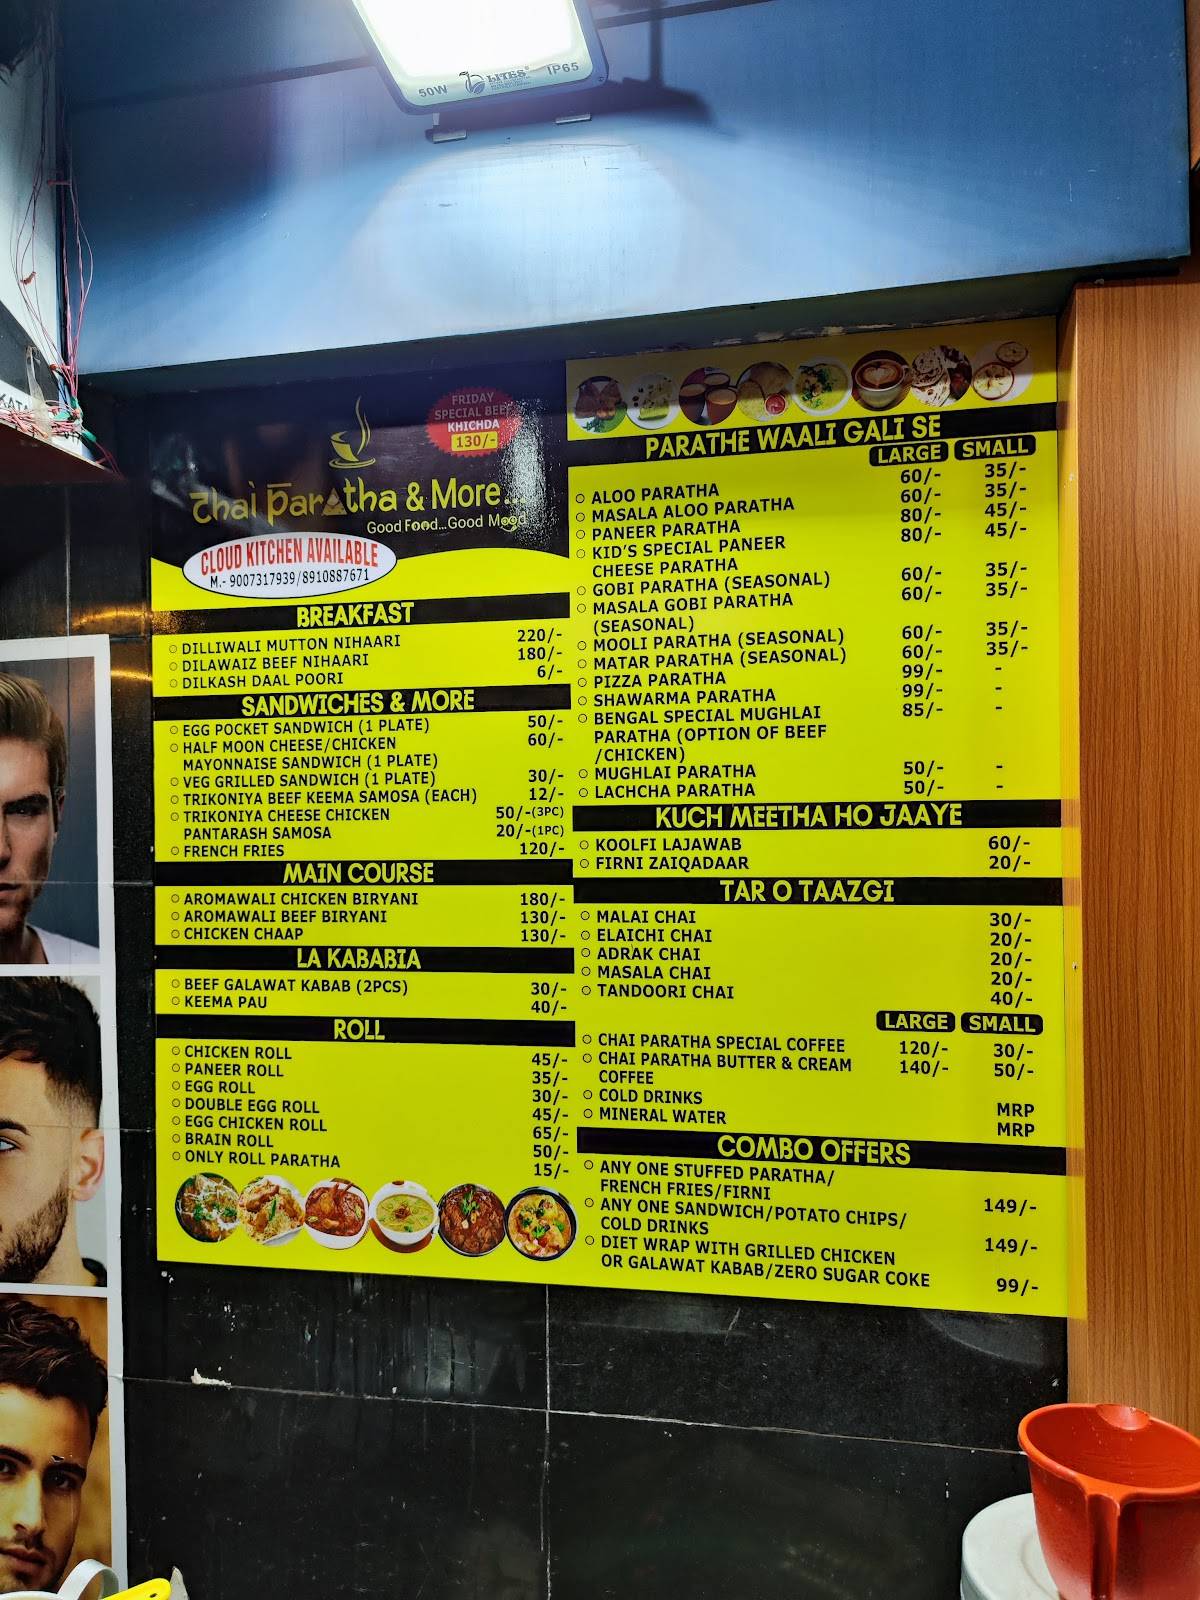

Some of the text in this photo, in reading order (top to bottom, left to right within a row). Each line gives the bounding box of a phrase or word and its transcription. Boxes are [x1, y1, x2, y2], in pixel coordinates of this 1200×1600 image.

[546, 62, 580, 77] IP65
[418, 85, 448, 98] 50W
[451, 391, 495, 406] FRIDAY
[434, 406, 482, 421] SPECIAL
[447, 418, 500, 433] KHICHDA
[456, 433, 496, 449] 130/-
[645, 414, 941, 460] PARATHE WAALI GALI SE
[879, 444, 940, 463] LARGE
[963, 438, 1028, 457] SMALL
[405, 481, 425, 512] &
[591, 482, 720, 505] ALOO PARATHA
[900, 487, 942, 505] 60/-
[900, 506, 942, 525] 80/-
[367, 520, 401, 534] Good
[592, 519, 741, 542] PANEER PARATHA
[201, 537, 379, 576] CLOUD KITCHEN AVAILABLE
[592, 557, 739, 578] CHEESE PARATHA
[901, 565, 942, 584] 60/-
[229, 568, 370, 588] 9007317939/8910887671
[592, 570, 830, 597] GOBI PARATHA (SEASONAL)
[901, 585, 942, 603] 60/-
[297, 602, 414, 627] BREAKFAST
[593, 615, 694, 637] (SEASONAL)
[517, 627, 562, 644] 220/-
[593, 627, 844, 652] MOOLI PARATHA (SEASONAL)
[902, 643, 943, 661] 60/-
[182, 653, 369, 672] DILAWAIZ BEEF NIHAARI
[537, 664, 563, 681] 6/-
[594, 671, 727, 689] PIZZA PARATHA
[902, 663, 943, 681] 99/-
[242, 689, 474, 716] SANDWICHES & MORE
[594, 705, 821, 726] BENGAL SPECIAL MUGHLAI
[183, 717, 430, 737] EGG POCKET SANDWICH (1 PLATE)
[594, 746, 685, 765] /CHICKEN)
[182, 770, 436, 789] VEG GRILLED SANDWICH (1 PLATE)
[594, 764, 757, 781] MUGHLAI PARATHA
[529, 786, 564, 803] 12/-
[903, 779, 944, 797] 50/-
[183, 807, 390, 823] TRIKONIYA CHEESE CHICKEN
[656, 803, 962, 828] KUCH MEETHA HO JAAYE
[183, 826, 332, 841] PANTARASH SAMOSA
[184, 844, 285, 858] FRENCH FRIES
[595, 837, 742, 852] KOOLFI LAJAWAB
[283, 863, 433, 883] MAIN COURSE
[989, 855, 1031, 873] 20/-
[720, 880, 894, 902] TAR O TAAZGI
[183, 909, 388, 923] AROMAWALI BEEF BIRYANI
[596, 909, 697, 924] MALAI CHAI
[520, 928, 566, 945] 130/-
[298, 948, 421, 969] LA KABABIA
[596, 946, 701, 962] ADRAK CHAI
[991, 971, 1033, 989] 20/-
[596, 983, 735, 1000] TANDOORI CHAI
[184, 995, 267, 1009] KEEMA PAU
[530, 1000, 567, 1017] 40/-
[334, 1019, 385, 1040] ROLL
[885, 1013, 947, 1029] LARGE
[970, 1015, 1035, 1032] SMALL
[184, 1044, 293, 1060] CHICKEN ROLL
[899, 1040, 949, 1059] 120/-
[184, 1062, 285, 1078] PANEER ROLL
[598, 1051, 852, 1073] CHAI PARATHA BUTTER & CREAM
[532, 1107, 569, 1125] 45/-
[599, 1106, 727, 1125] MINERAL WATER
[996, 1102, 1035, 1118] MRP
[185, 1114, 328, 1132] EGG CHICKEN ROLL
[185, 1132, 274, 1148] BRAIN ROLL
[533, 1144, 569, 1161] 50/-
[717, 1135, 910, 1165] COMBO OFFERS
[600, 1178, 771, 1201] FRENCH FRIES/FIRNI
[984, 1197, 1037, 1217] 149/-
[600, 1215, 709, 1236] COLD DRINKS
[601, 1234, 896, 1266] DIET WRAP WITH GRILLED CHICKEN
[996, 1277, 1039, 1297] 99/-
